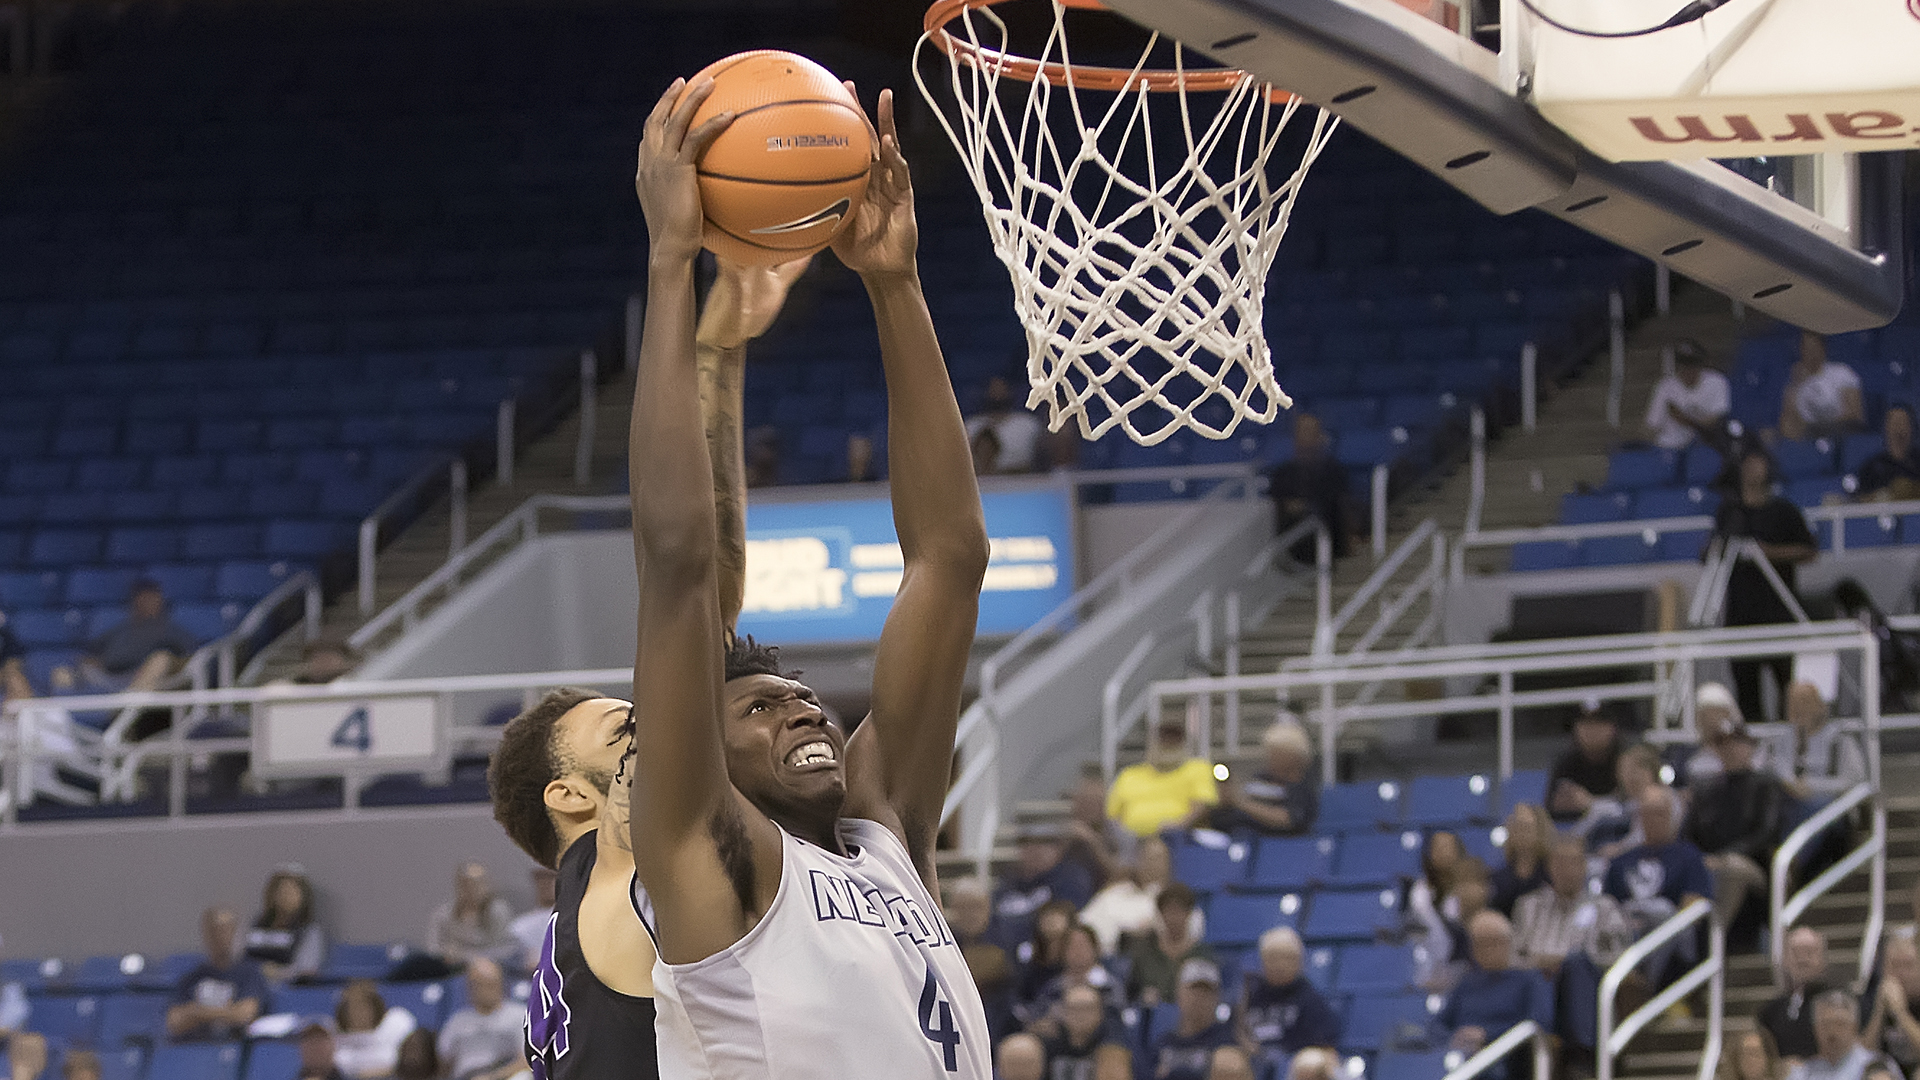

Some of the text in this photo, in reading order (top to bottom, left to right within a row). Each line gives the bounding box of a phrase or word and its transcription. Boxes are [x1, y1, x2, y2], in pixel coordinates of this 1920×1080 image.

[1628, 111, 1920, 143] arm
[331, 707, 370, 751] 4
[917, 962, 960, 1072] 4
